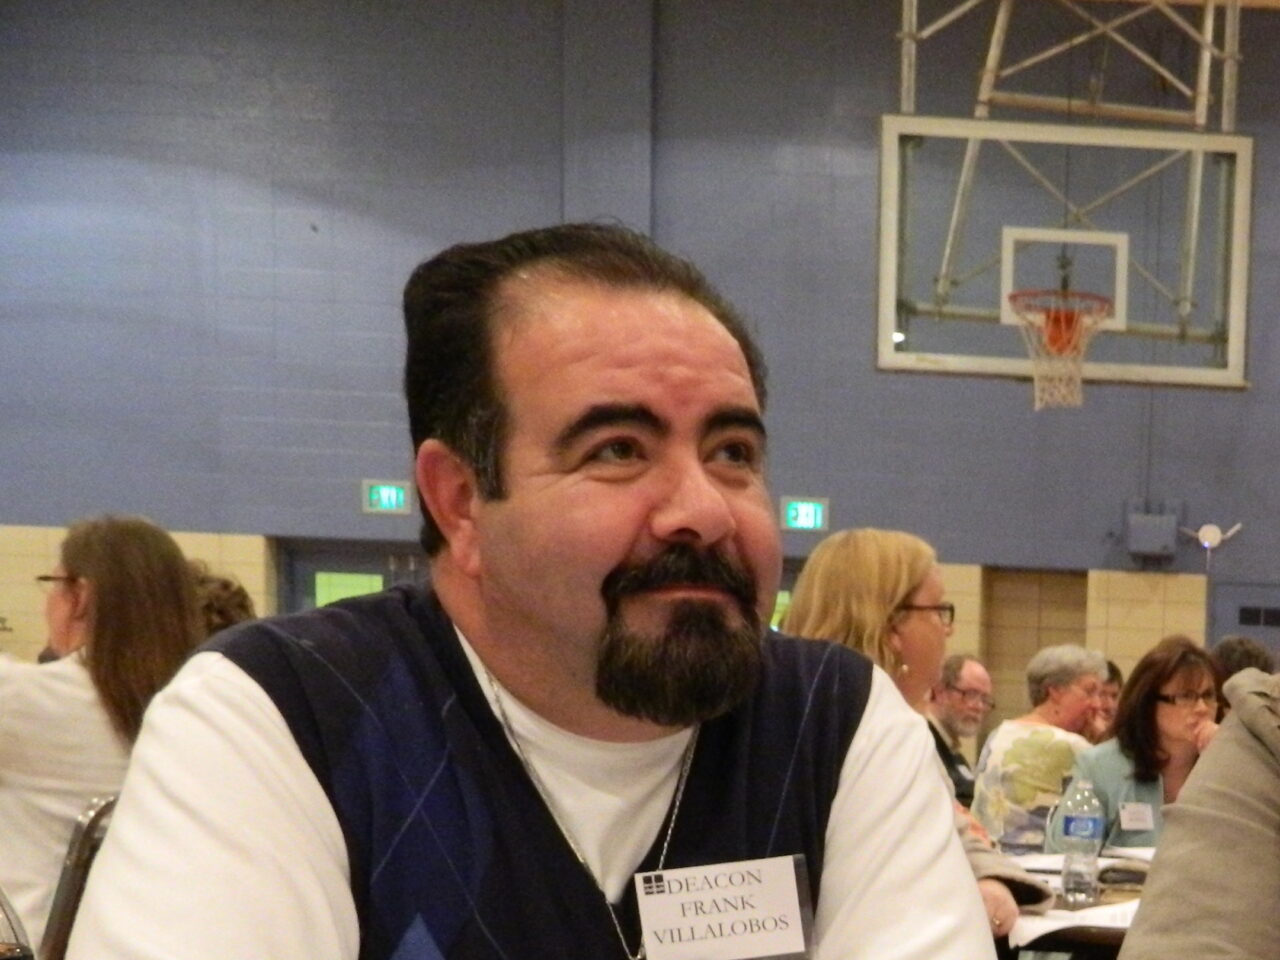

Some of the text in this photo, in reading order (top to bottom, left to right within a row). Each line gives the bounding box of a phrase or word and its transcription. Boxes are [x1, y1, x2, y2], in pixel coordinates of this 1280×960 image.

[667, 869, 762, 894] DEACON
[680, 894, 756, 917] FRANK
[653, 914, 789, 944] VILLALOBOS
